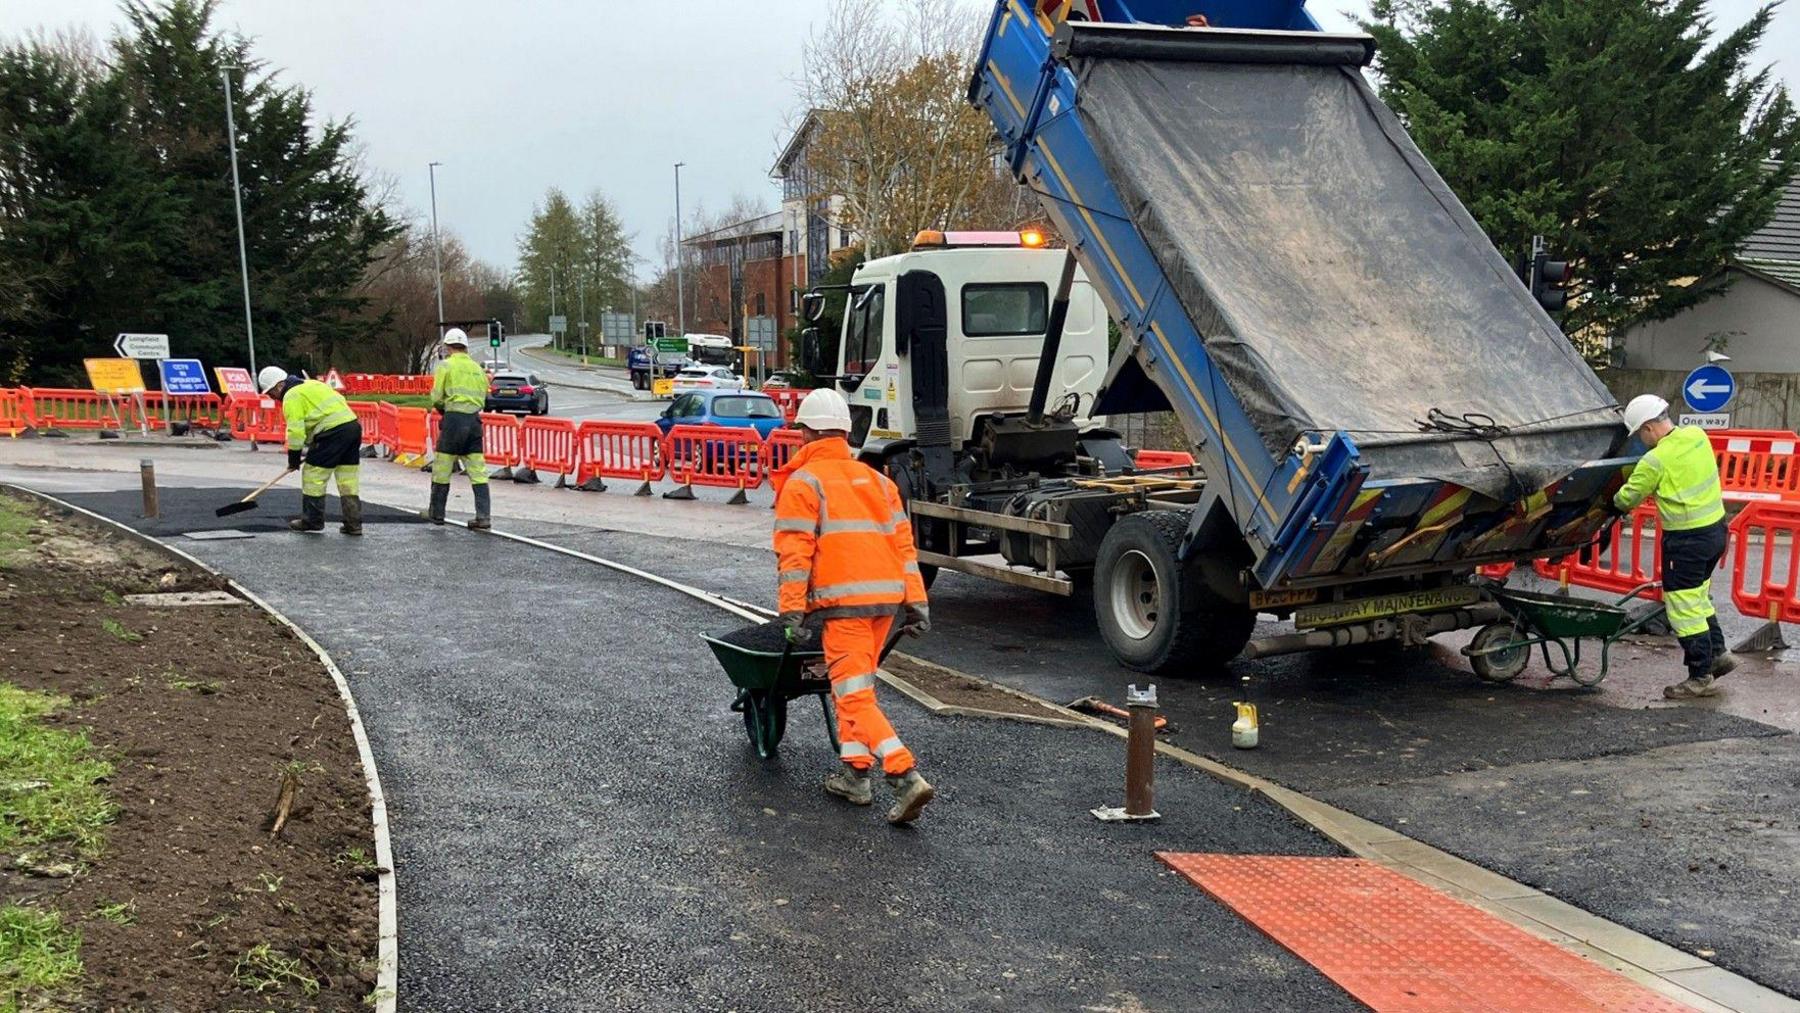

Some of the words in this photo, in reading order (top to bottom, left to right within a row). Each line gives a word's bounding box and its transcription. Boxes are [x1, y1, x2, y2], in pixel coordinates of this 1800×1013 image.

[1682, 417, 1703, 425] One
[1706, 418, 1727, 426] way
[1373, 590, 1474, 613] MAINTENANCE
